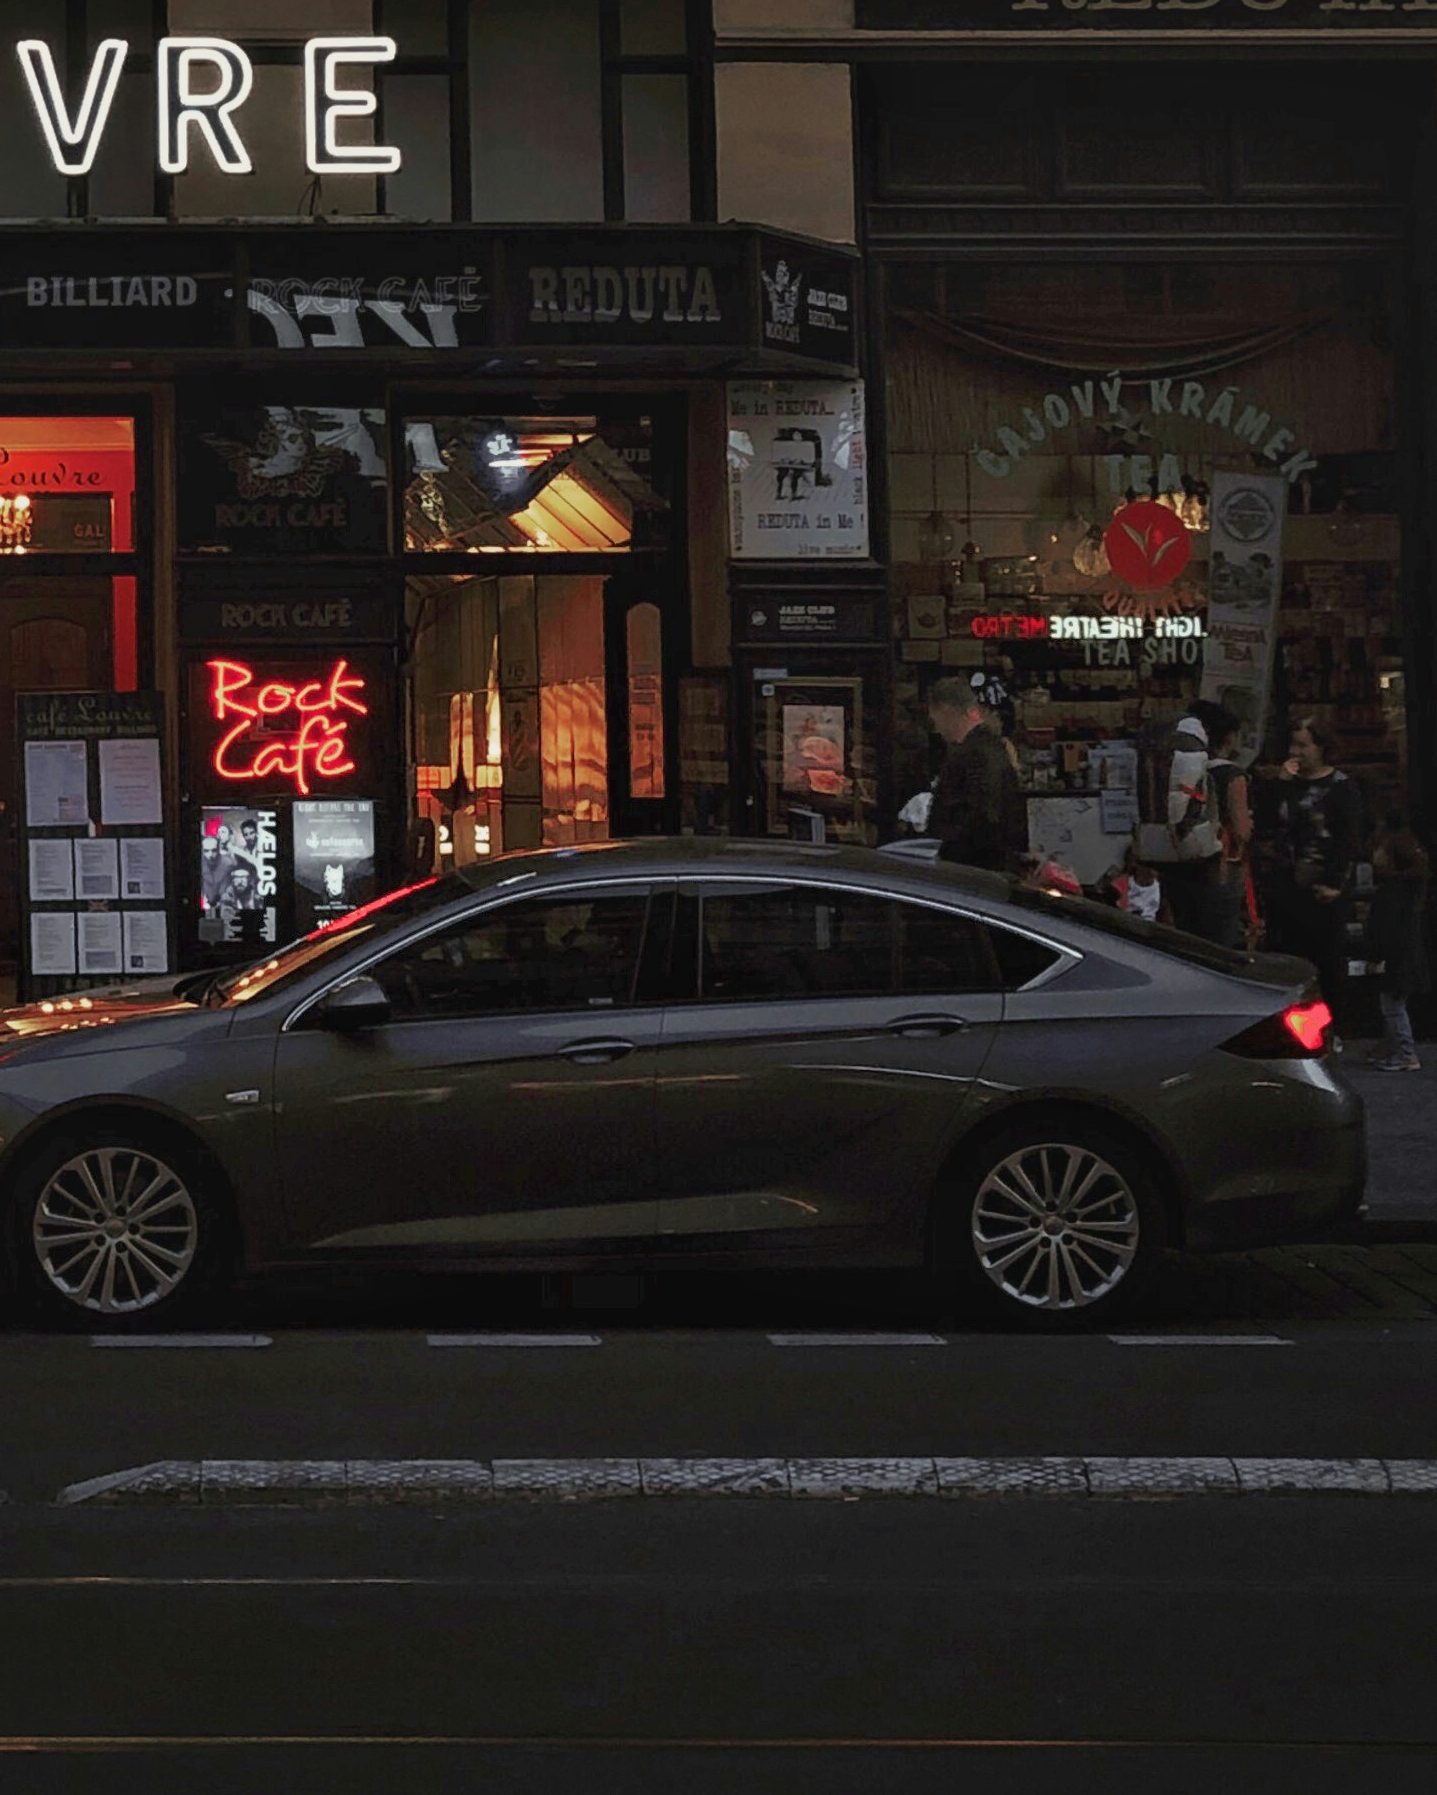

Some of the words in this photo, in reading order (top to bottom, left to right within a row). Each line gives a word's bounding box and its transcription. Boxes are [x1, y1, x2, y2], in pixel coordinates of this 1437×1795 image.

[26, 275, 198, 308] BILLIARD
[250, 277, 366, 314] ROCK
[376, 266, 483, 313] CAFÉ
[528, 266, 722, 323] REDUTA
[1149, 377, 1319, 484] KRÁMEK
[1105, 453, 1183, 494] TEA
[221, 603, 288, 629] ROCK
[292, 597, 352, 629] CAFÉ
[1081, 638, 1131, 666] TEA
[1142, 636, 1198, 665] SHO
[206, 659, 368, 720] Rock
[215, 714, 355, 795] Café
